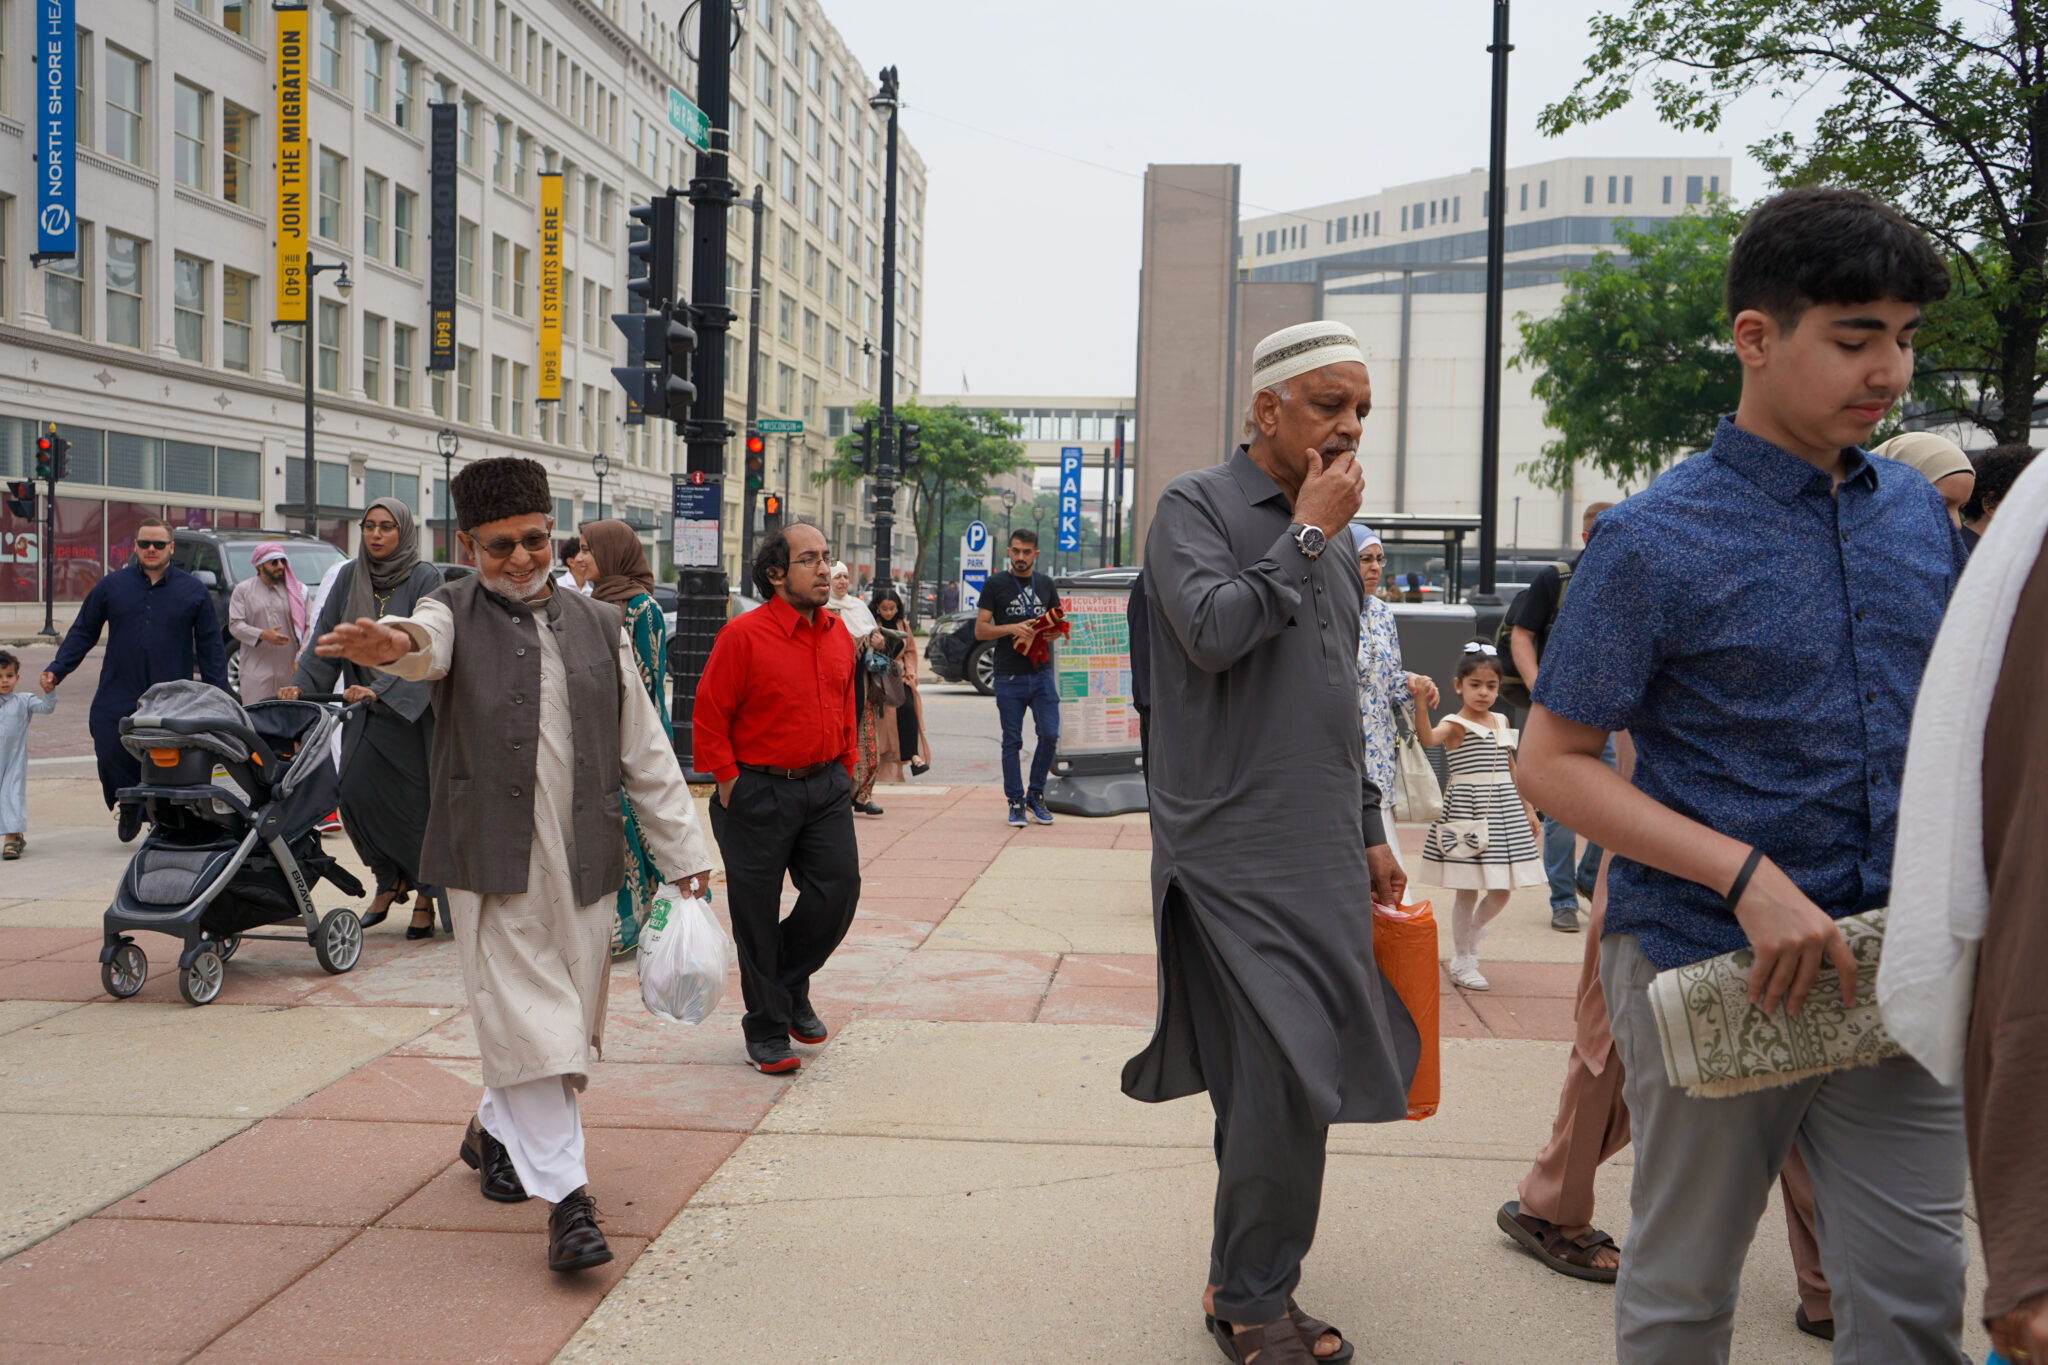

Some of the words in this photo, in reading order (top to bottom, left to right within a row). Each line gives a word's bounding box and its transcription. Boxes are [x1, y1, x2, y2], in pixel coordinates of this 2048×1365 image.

[48, 41, 62, 115] SHORE
[282, 30, 300, 143] MIGRATION
[48, 121, 62, 196] NORTH
[282, 149, 300, 186] THE
[282, 193, 300, 238] JOIN
[544, 207, 558, 256] HERE
[285, 254, 300, 262] HUB
[285, 267, 300, 296] 640
[543, 260, 558, 311] STARTS
[436, 322, 451, 347] 640
[543, 316, 557, 329] IT
[1062, 457, 1078, 532] PARK
[53, 544, 96, 560] pening
[971, 525, 984, 549] P
[1005, 603, 1047, 617] adias
[291, 870, 314, 914] BRAVO
